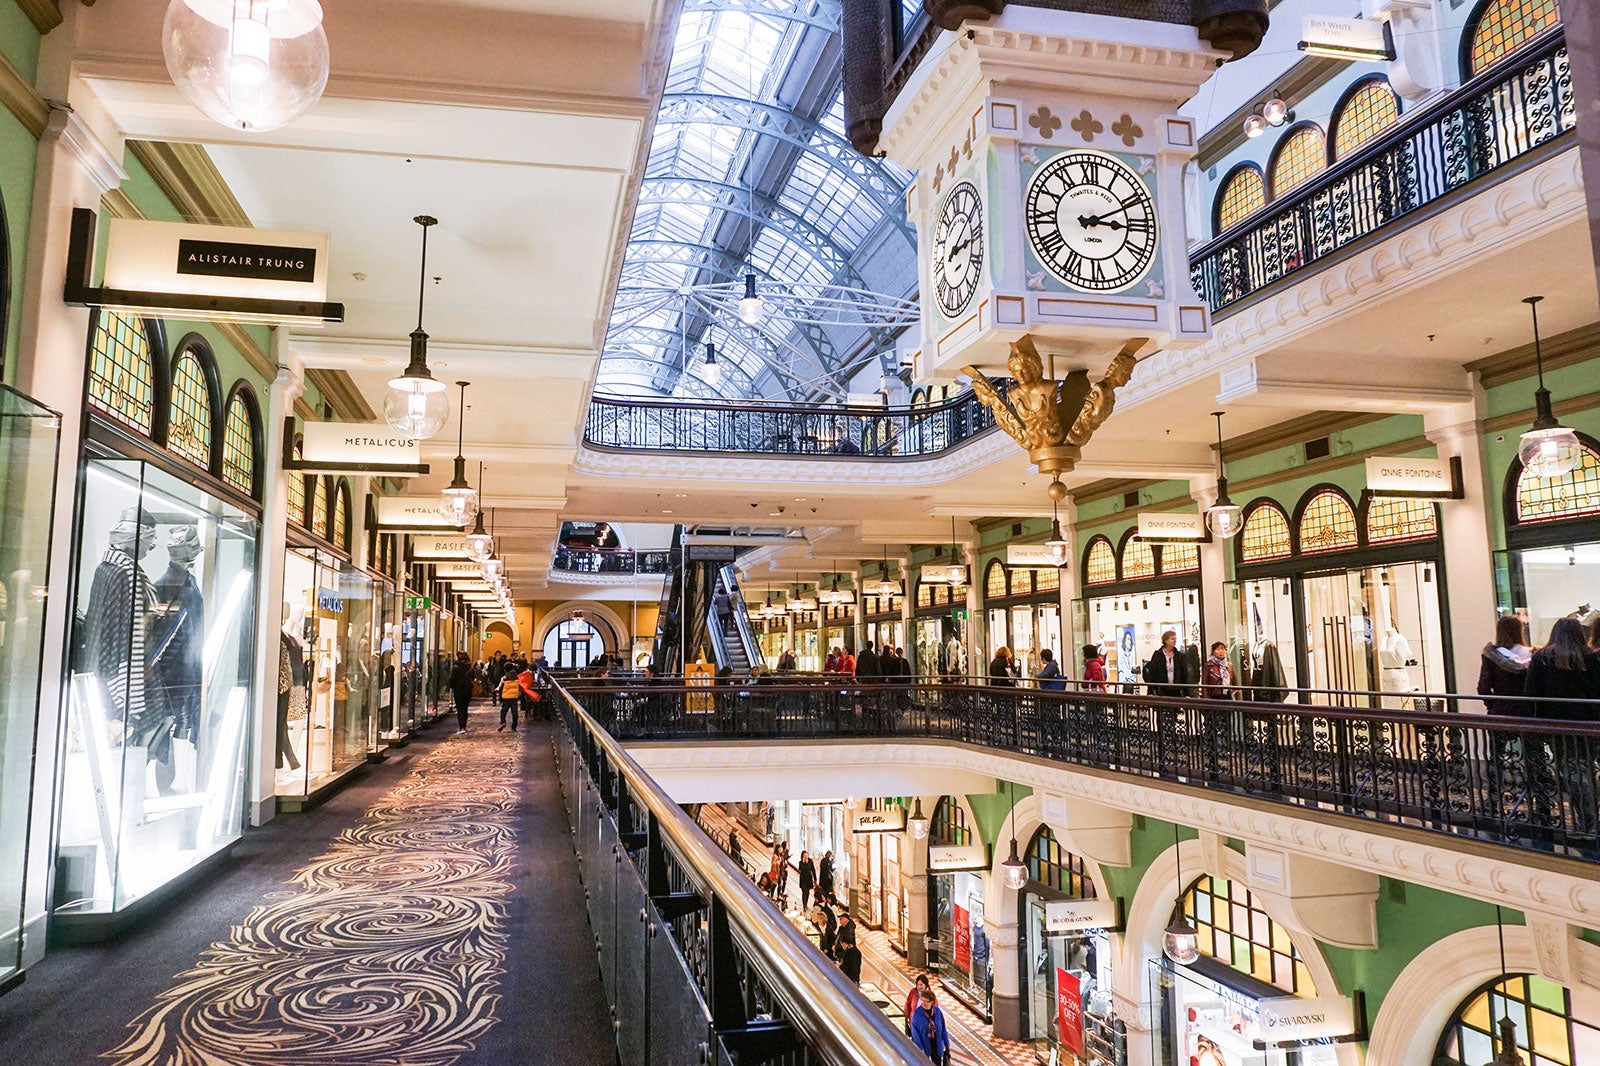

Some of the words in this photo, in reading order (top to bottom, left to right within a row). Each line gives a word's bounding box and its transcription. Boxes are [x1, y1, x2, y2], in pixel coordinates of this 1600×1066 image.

[188, 253, 252, 266] ALISTAIR
[258, 258, 305, 269] TRUNG
[345, 438, 414, 448] METALICUS
[1059, 993, 1081, 1015] 30-50%
[1063, 1006, 1077, 1022] OFF
[1279, 1014, 1326, 1027] SWAROVSKI
